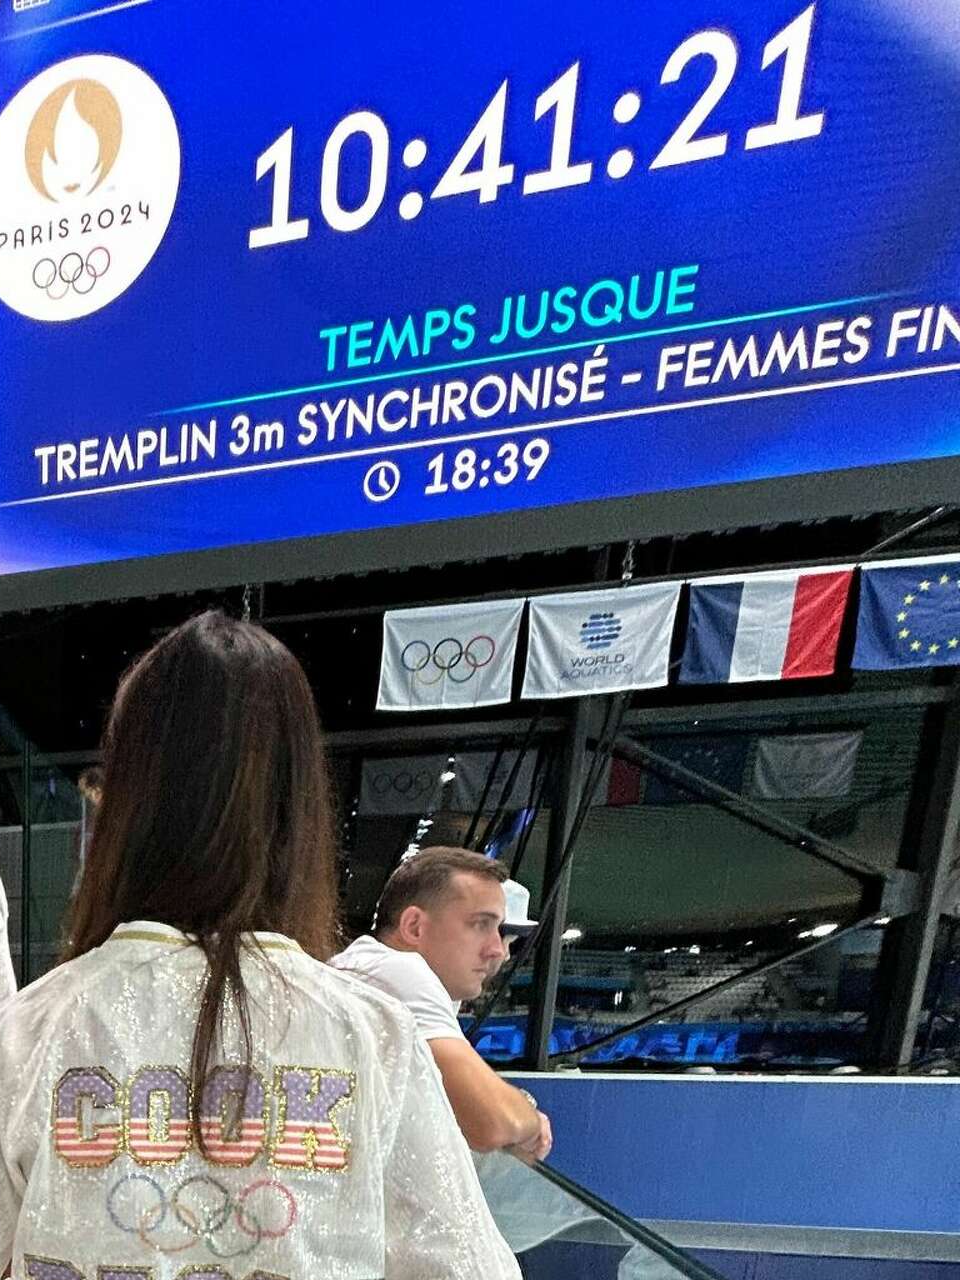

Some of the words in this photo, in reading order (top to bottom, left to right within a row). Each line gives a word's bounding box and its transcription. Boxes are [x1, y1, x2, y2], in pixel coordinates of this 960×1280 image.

[248, 3, 824, 249] 10:41:21
[80, 200, 150, 234] 2024
[319, 304, 477, 372] TEMPS
[487, 264, 699, 345] JUSQUE
[34, 414, 218, 486] TREMPLIN
[229, 414, 286, 456] 3m
[297, 343, 609, 446] SYNCHRONISÉ
[655, 315, 872, 392] FEMMES
[424, 438, 550, 496] 18:39
[560, 663, 633, 680] AQUATICS
[570, 653, 625, 668] WORLD
[51, 1063, 357, 1173] COOK
